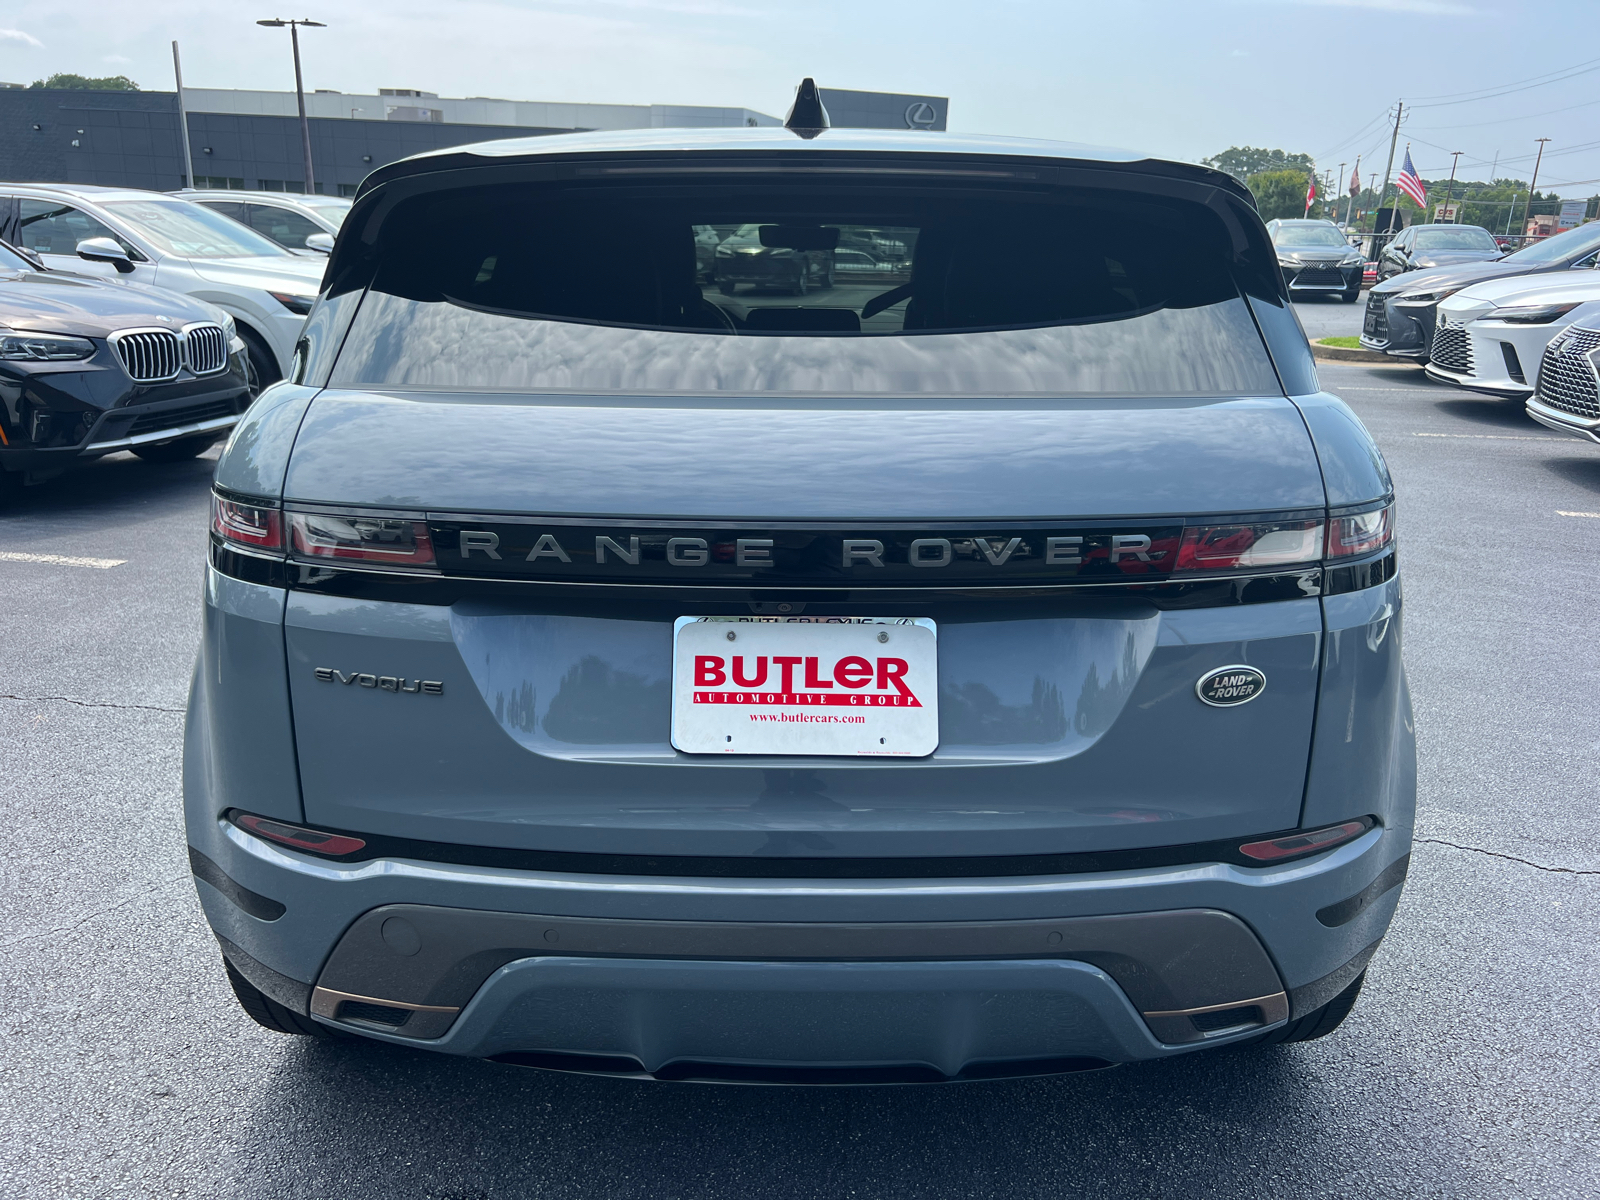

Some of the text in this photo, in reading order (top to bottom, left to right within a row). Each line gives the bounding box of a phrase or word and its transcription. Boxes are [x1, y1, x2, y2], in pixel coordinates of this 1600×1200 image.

[459, 530, 1152, 568] RANGE ROVER
[314, 667, 444, 695] EVOQUE
[1213, 674, 1246, 688] LAND
[1214, 685, 1255, 698] ROVER
[694, 692, 914, 706] AUTOMOTIVE GROUP
[750, 712, 866, 724] www.butlercars.com
